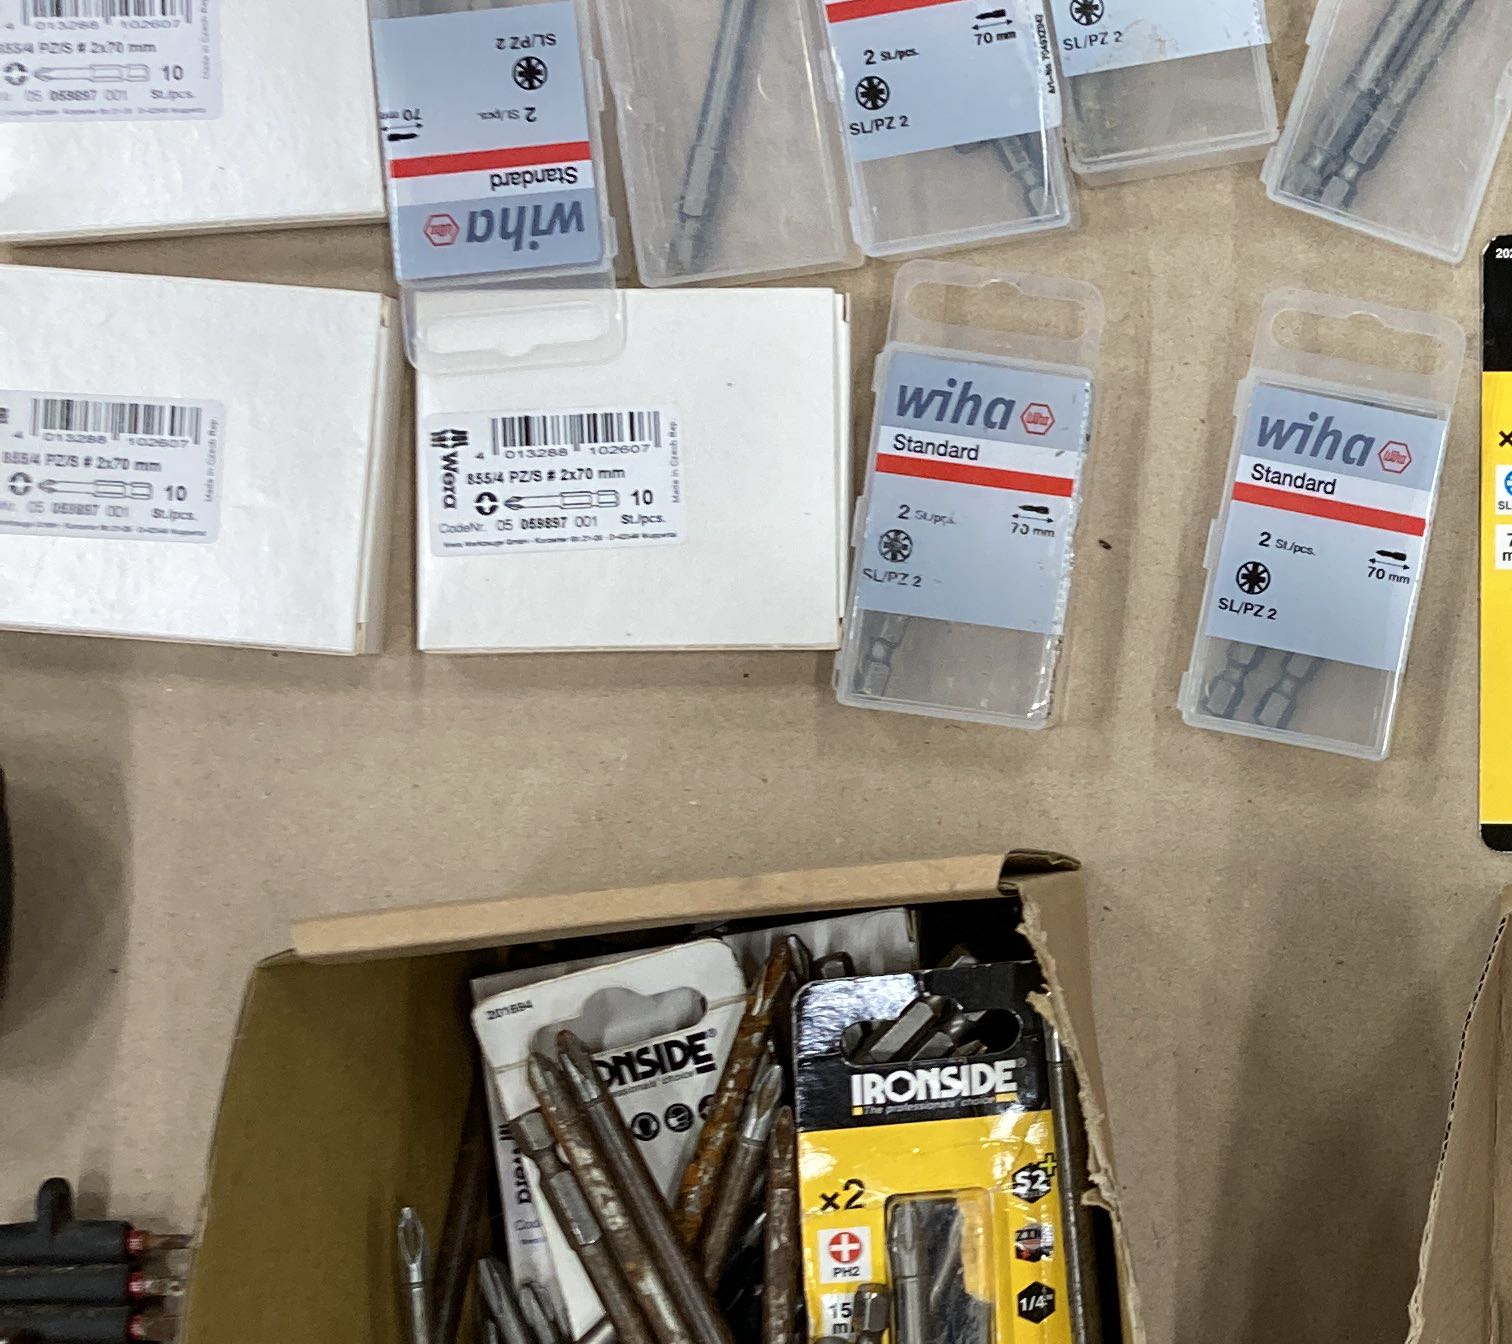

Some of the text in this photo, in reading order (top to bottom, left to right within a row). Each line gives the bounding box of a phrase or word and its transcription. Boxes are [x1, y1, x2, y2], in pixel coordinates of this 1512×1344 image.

[974, 32, 993, 46] 70
[1112, 30, 1124, 44] 2
[863, 49, 877, 65] 2
[161, 65, 184, 81] 10
[403, 107, 537, 123] 70 2
[849, 114, 911, 136] SL/PZ 2
[490, 166, 579, 192] Standard
[465, 201, 586, 252] wiha
[896, 377, 1017, 431] wiha
[893, 433, 980, 461] Standard
[1257, 411, 1376, 467] wiha
[442, 450, 460, 510] Wera
[467, 471, 504, 485] 855/4
[560, 467, 593, 481] 2x70
[599, 467, 626, 480] mm
[1251, 463, 1337, 495] Standard
[165, 485, 188, 502] 10
[631, 489, 654, 506] 10
[897, 504, 911, 520] 2
[1032, 525, 1056, 538] mm
[1258, 531, 1272, 547] 2
[912, 575, 923, 588] 2
[1367, 566, 1411, 585] 70 mm
[1218, 597, 1278, 620] SL/PZ 2
[833, 1265, 859, 1278] PH2
[828, 1301, 852, 1321] 15
